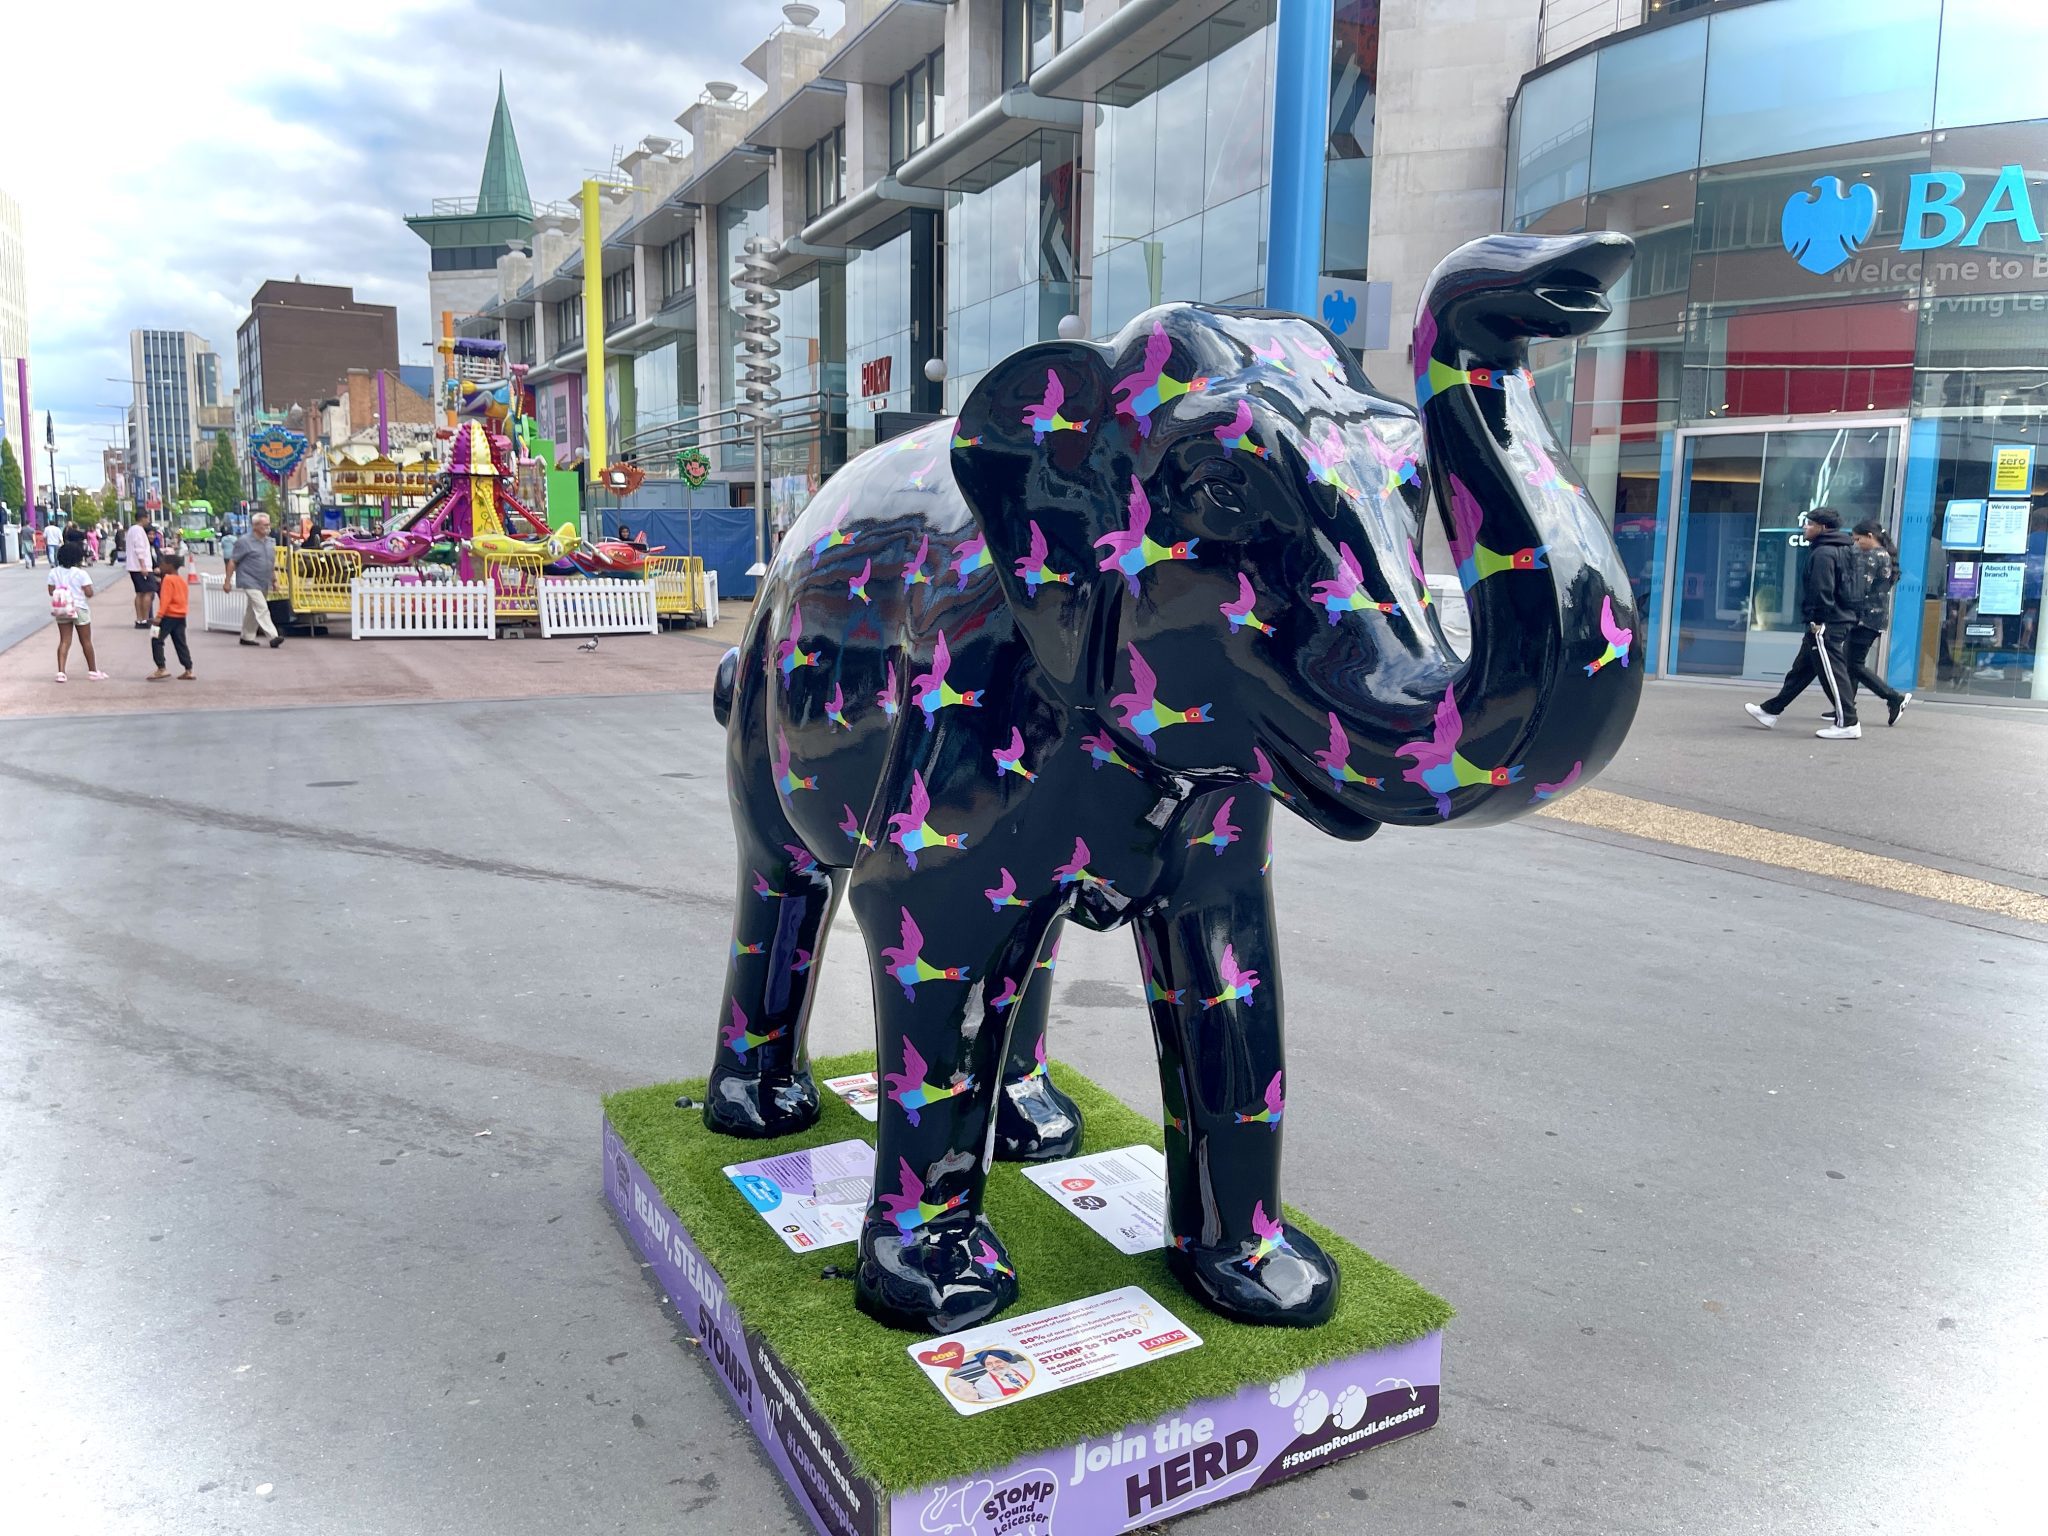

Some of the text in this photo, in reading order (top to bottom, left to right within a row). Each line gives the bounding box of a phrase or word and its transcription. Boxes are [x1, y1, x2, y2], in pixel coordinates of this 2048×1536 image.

[1898, 164, 2043, 252] BA
[1832, 257, 1979, 284] Welcome
[1987, 256, 2023, 280] to
[2012, 293, 2048, 311] Le
[862, 355, 892, 397] ROXY
[634, 1183, 723, 1321] READY, STEADY
[1006, 1323, 1032, 1332] LOROS
[1018, 1334, 1046, 1345] 80%
[1140, 1330, 1186, 1348] LOROS
[699, 1303, 752, 1413] STOMP!
[931, 1351, 957, 1362] 40th
[1036, 1328, 1144, 1364] STOMP to 70450
[1054, 1356, 1084, 1368] donate
[1059, 1361, 1087, 1372] LOROS
[758, 1346, 861, 1513] #StompRoundLeicester
[1282, 1404, 1426, 1470] #StompRoundLeicester
[1070, 1417, 1214, 1486] Join the
[1126, 1428, 1259, 1518] HERD
[983, 1481, 1055, 1520] STOMP
[998, 1501, 1035, 1523] round
[993, 1512, 1049, 1536] Leicester
